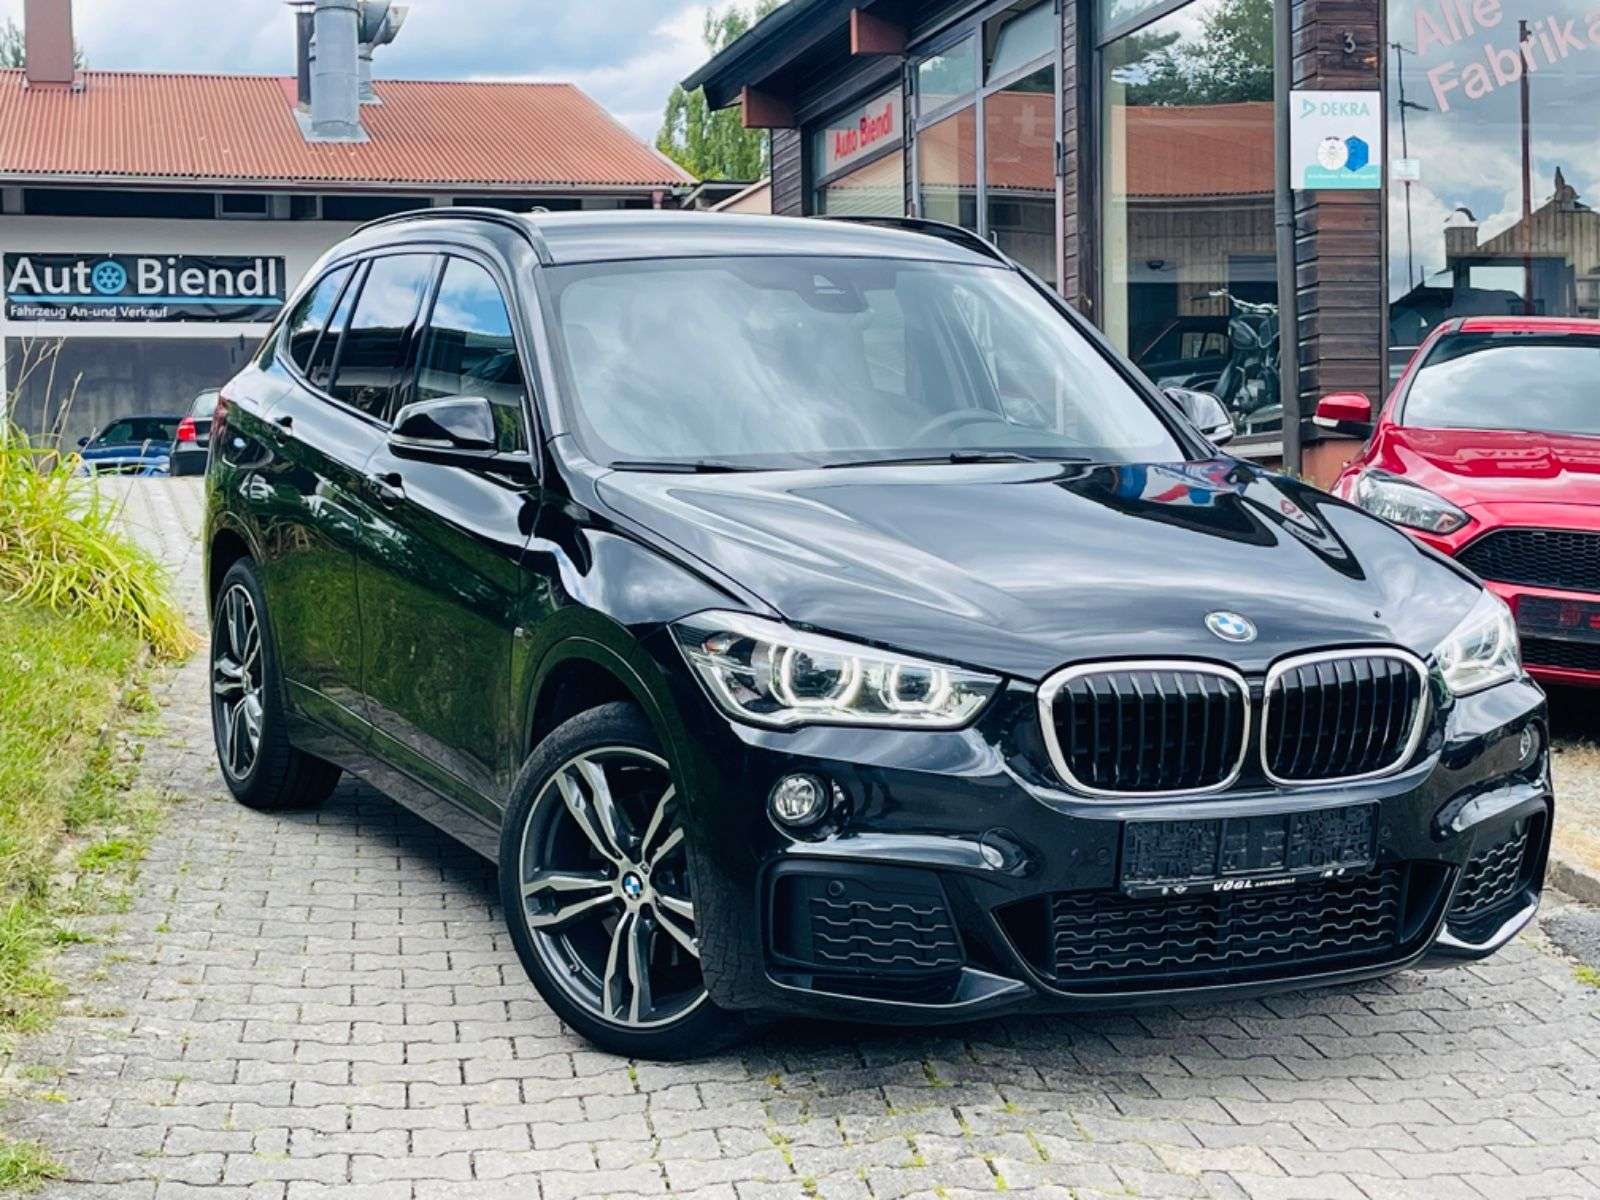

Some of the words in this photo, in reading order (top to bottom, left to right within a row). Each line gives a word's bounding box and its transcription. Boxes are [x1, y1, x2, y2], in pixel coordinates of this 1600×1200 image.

[1344, 32, 1356, 53] 3
[1413, 0, 1503, 57] Alle
[1320, 101, 1370, 116] DEKRA
[834, 128, 857, 161] Auto
[860, 103, 892, 147] Biendl
[8, 257, 127, 295] Auto
[137, 257, 276, 296] Biendl
[10, 304, 67, 319] Fahrzeug
[119, 306, 169, 318] Verkauf
